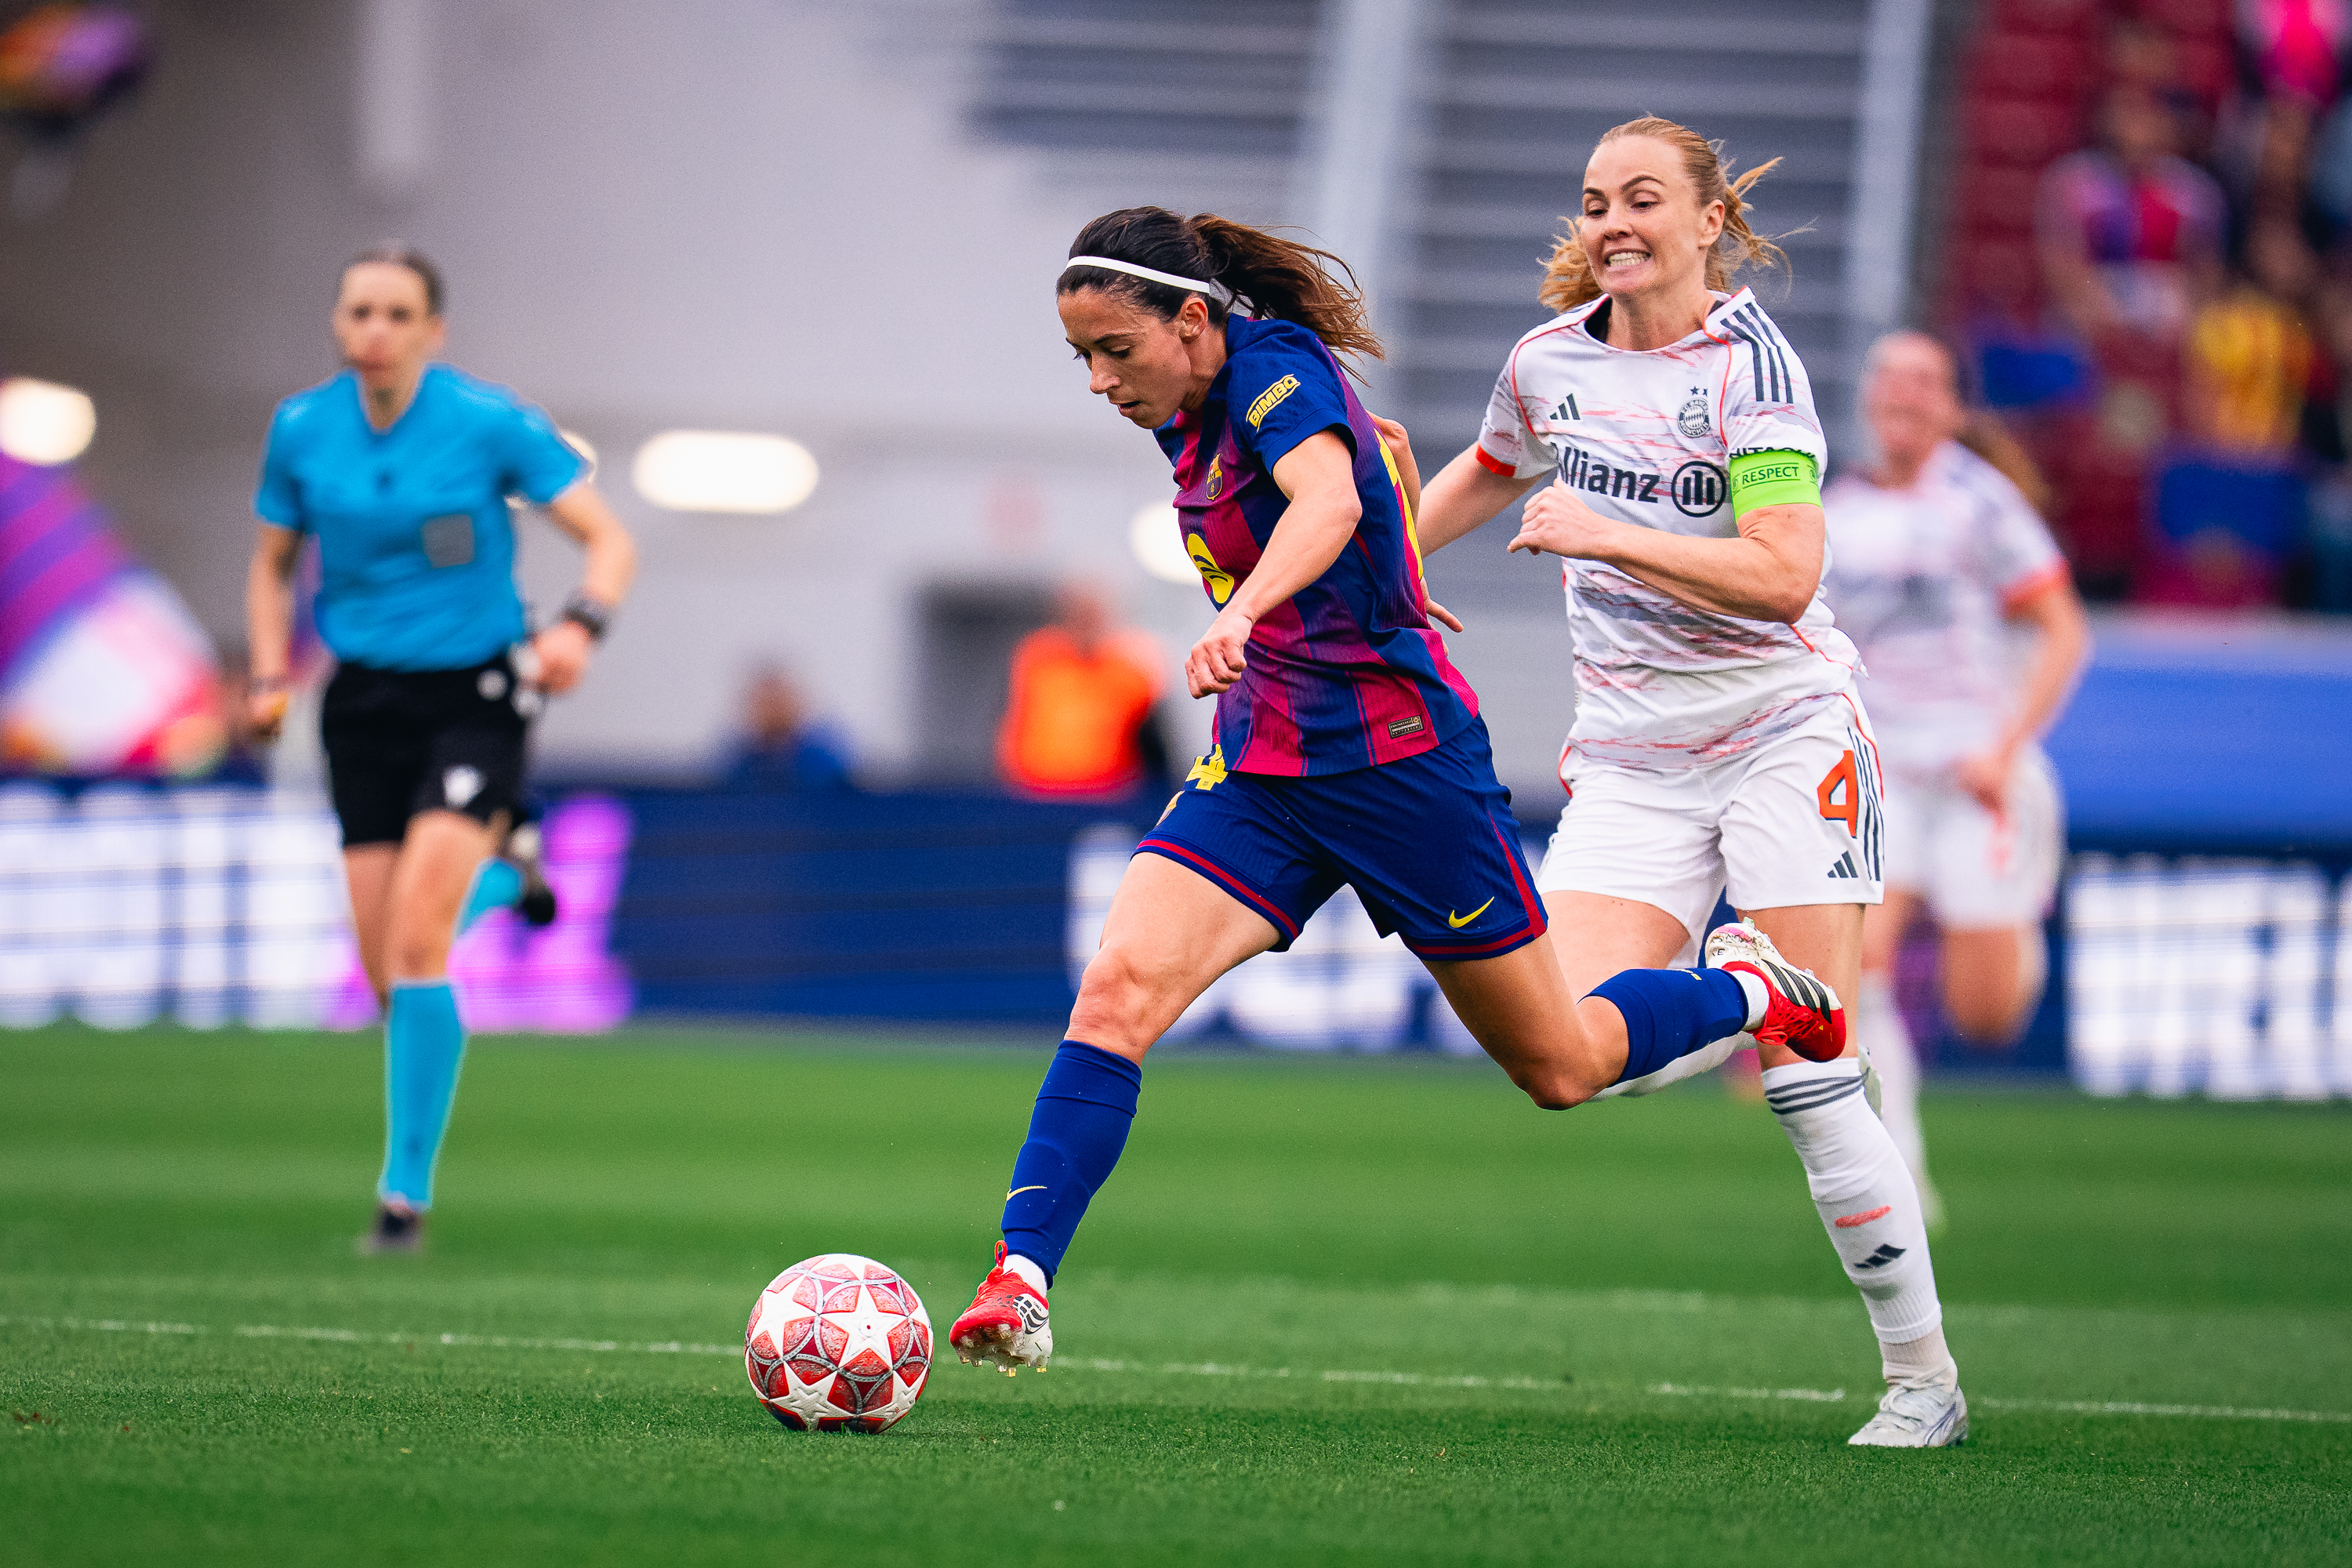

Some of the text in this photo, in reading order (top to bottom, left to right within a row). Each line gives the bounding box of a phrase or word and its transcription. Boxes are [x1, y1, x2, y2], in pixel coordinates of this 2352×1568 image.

[1248, 376, 1298, 427] BIMBO
[1551, 442, 1661, 503] llianz
[1742, 466, 1799, 485] RESPECT
[1817, 750, 1859, 839] 4
